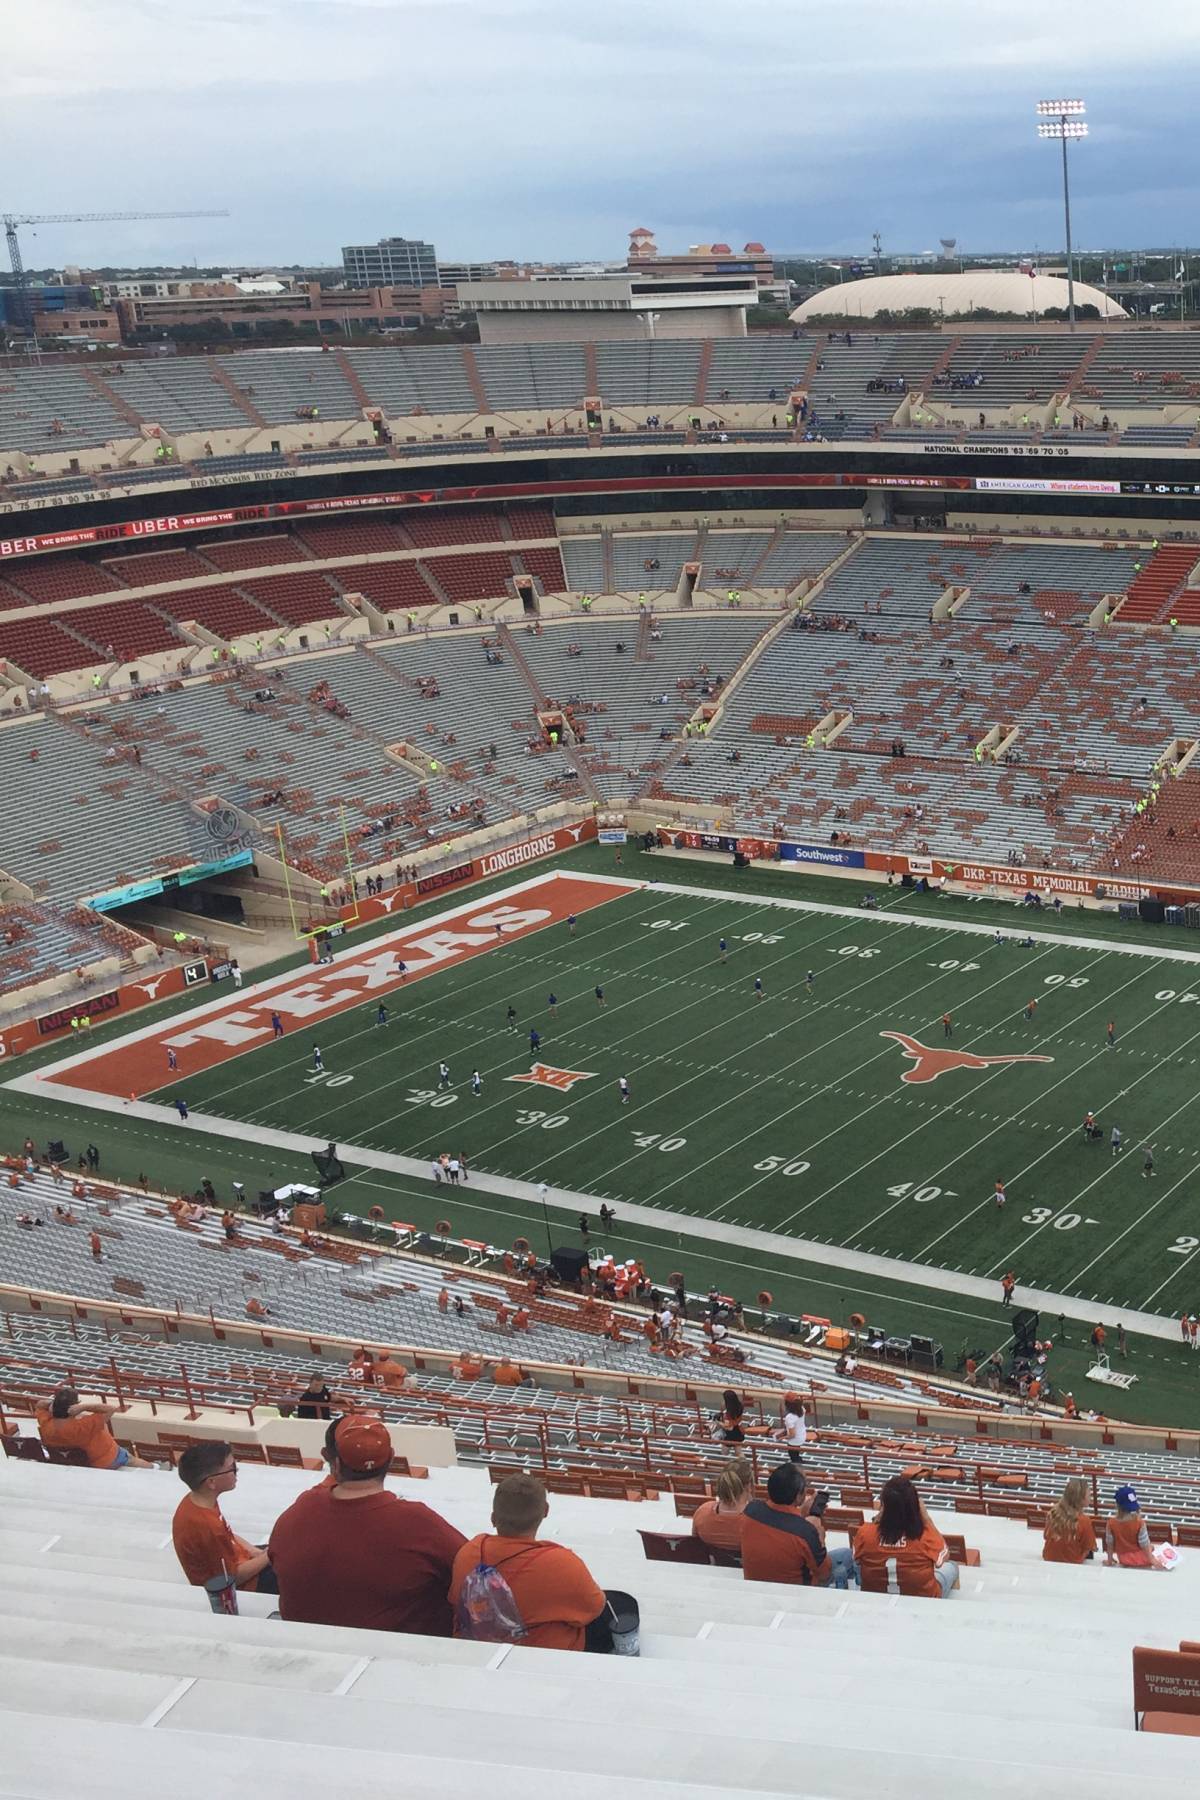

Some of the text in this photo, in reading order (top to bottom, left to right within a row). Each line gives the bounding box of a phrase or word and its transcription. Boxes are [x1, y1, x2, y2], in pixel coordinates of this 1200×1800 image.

[924, 446, 961, 454] NATIONAL
[964, 446, 1009, 454] CHAMPIONS
[132, 517, 180, 535] UBER
[202, 834, 252, 864] Allstate
[480, 834, 556, 877] LONGHORNS
[796, 848, 842, 863] Southwest
[418, 863, 474, 894] NISSAN
[963, 866, 1028, 885] DKR-TEXAS
[1033, 876, 1093, 894] MEMORIAL
[160, 905, 552, 1048] TEXAS
[42, 993, 117, 1032] NISSAN
[303, 1070, 354, 1087] 10
[405, 1089, 458, 1108] 20
[515, 1110, 570, 1129] 30
[634, 1134, 686, 1152] 40
[753, 1156, 810, 1176] 50
[886, 1182, 942, 1202] 40
[1022, 1207, 1082, 1230] 30
[348, 1368, 364, 1380] 32
[364, 1460, 374, 1470] T
[886, 1558, 900, 1594] 1
[1144, 1674, 1181, 1684] SUPPORT
